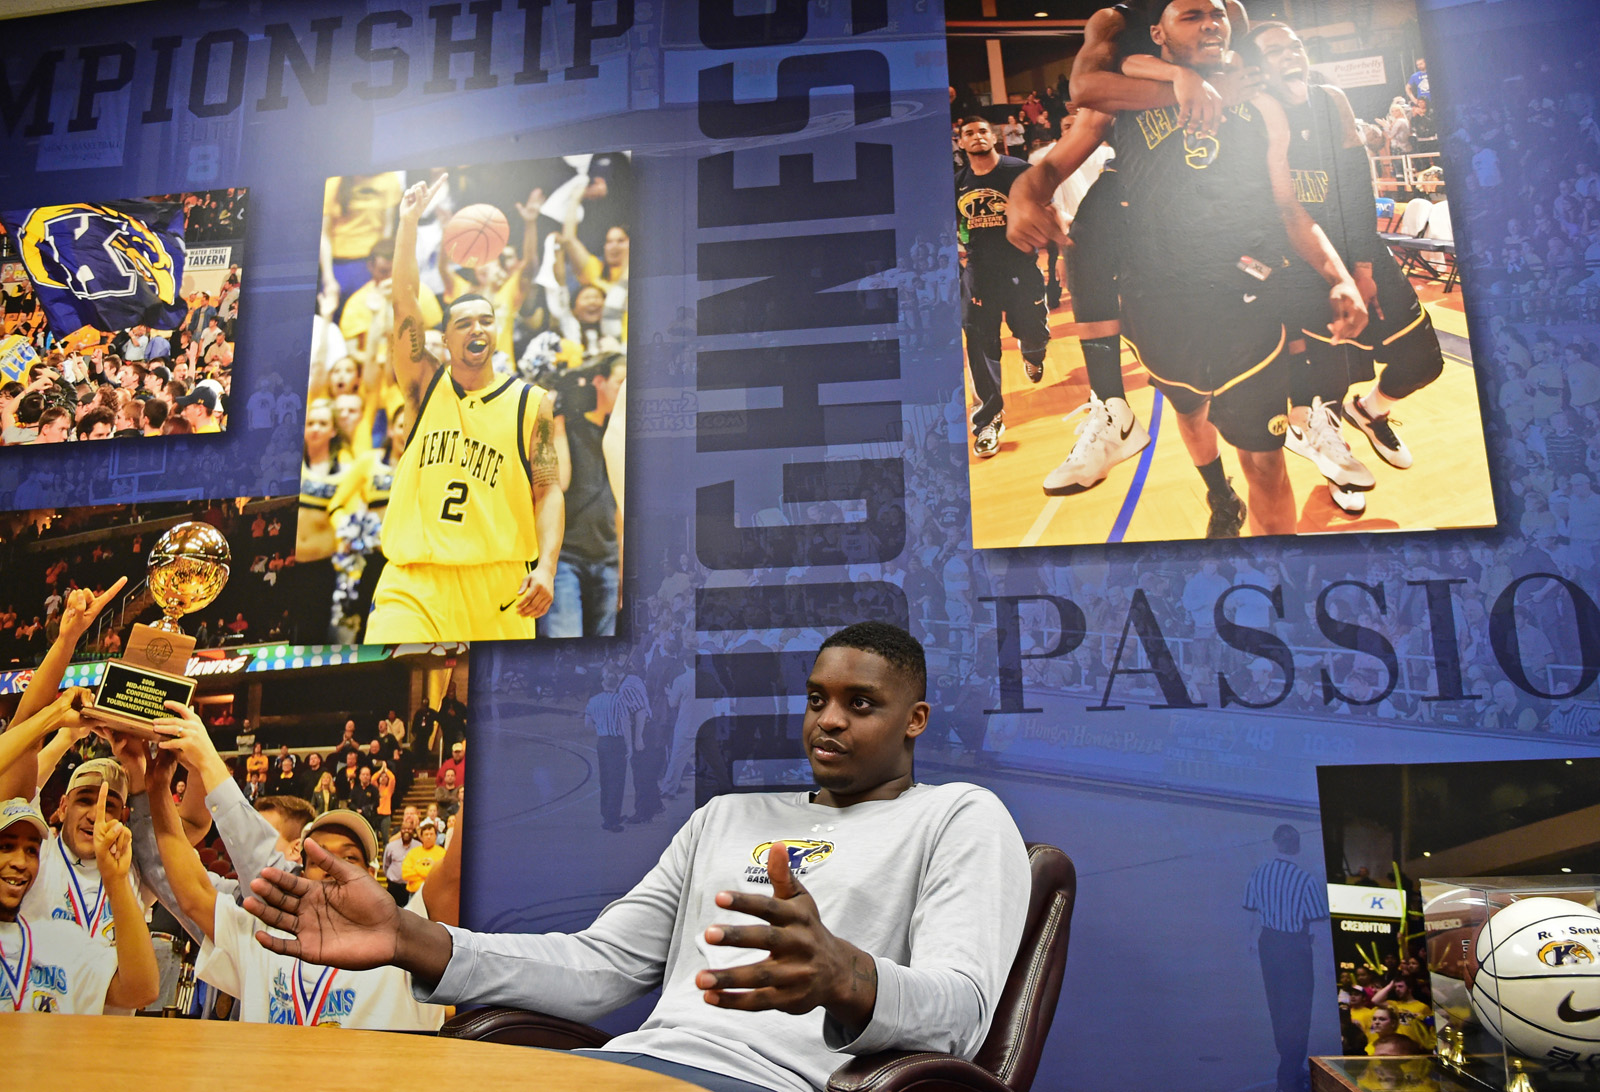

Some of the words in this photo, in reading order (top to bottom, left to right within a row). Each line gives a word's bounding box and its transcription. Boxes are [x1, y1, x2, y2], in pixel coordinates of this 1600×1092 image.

[188, 254, 226, 266] TAVERN
[418, 430, 460, 469] KENT
[460, 438, 505, 489] STATE
[439, 480, 470, 523] 2
[977, 572, 1600, 714] PASSIO
[115, 692, 134, 702] MEN'S
[125, 688, 163, 703] CONFERENCE
[126, 681, 167, 697] MID-AMERICAN
[106, 697, 144, 713] TOURNAMENT
